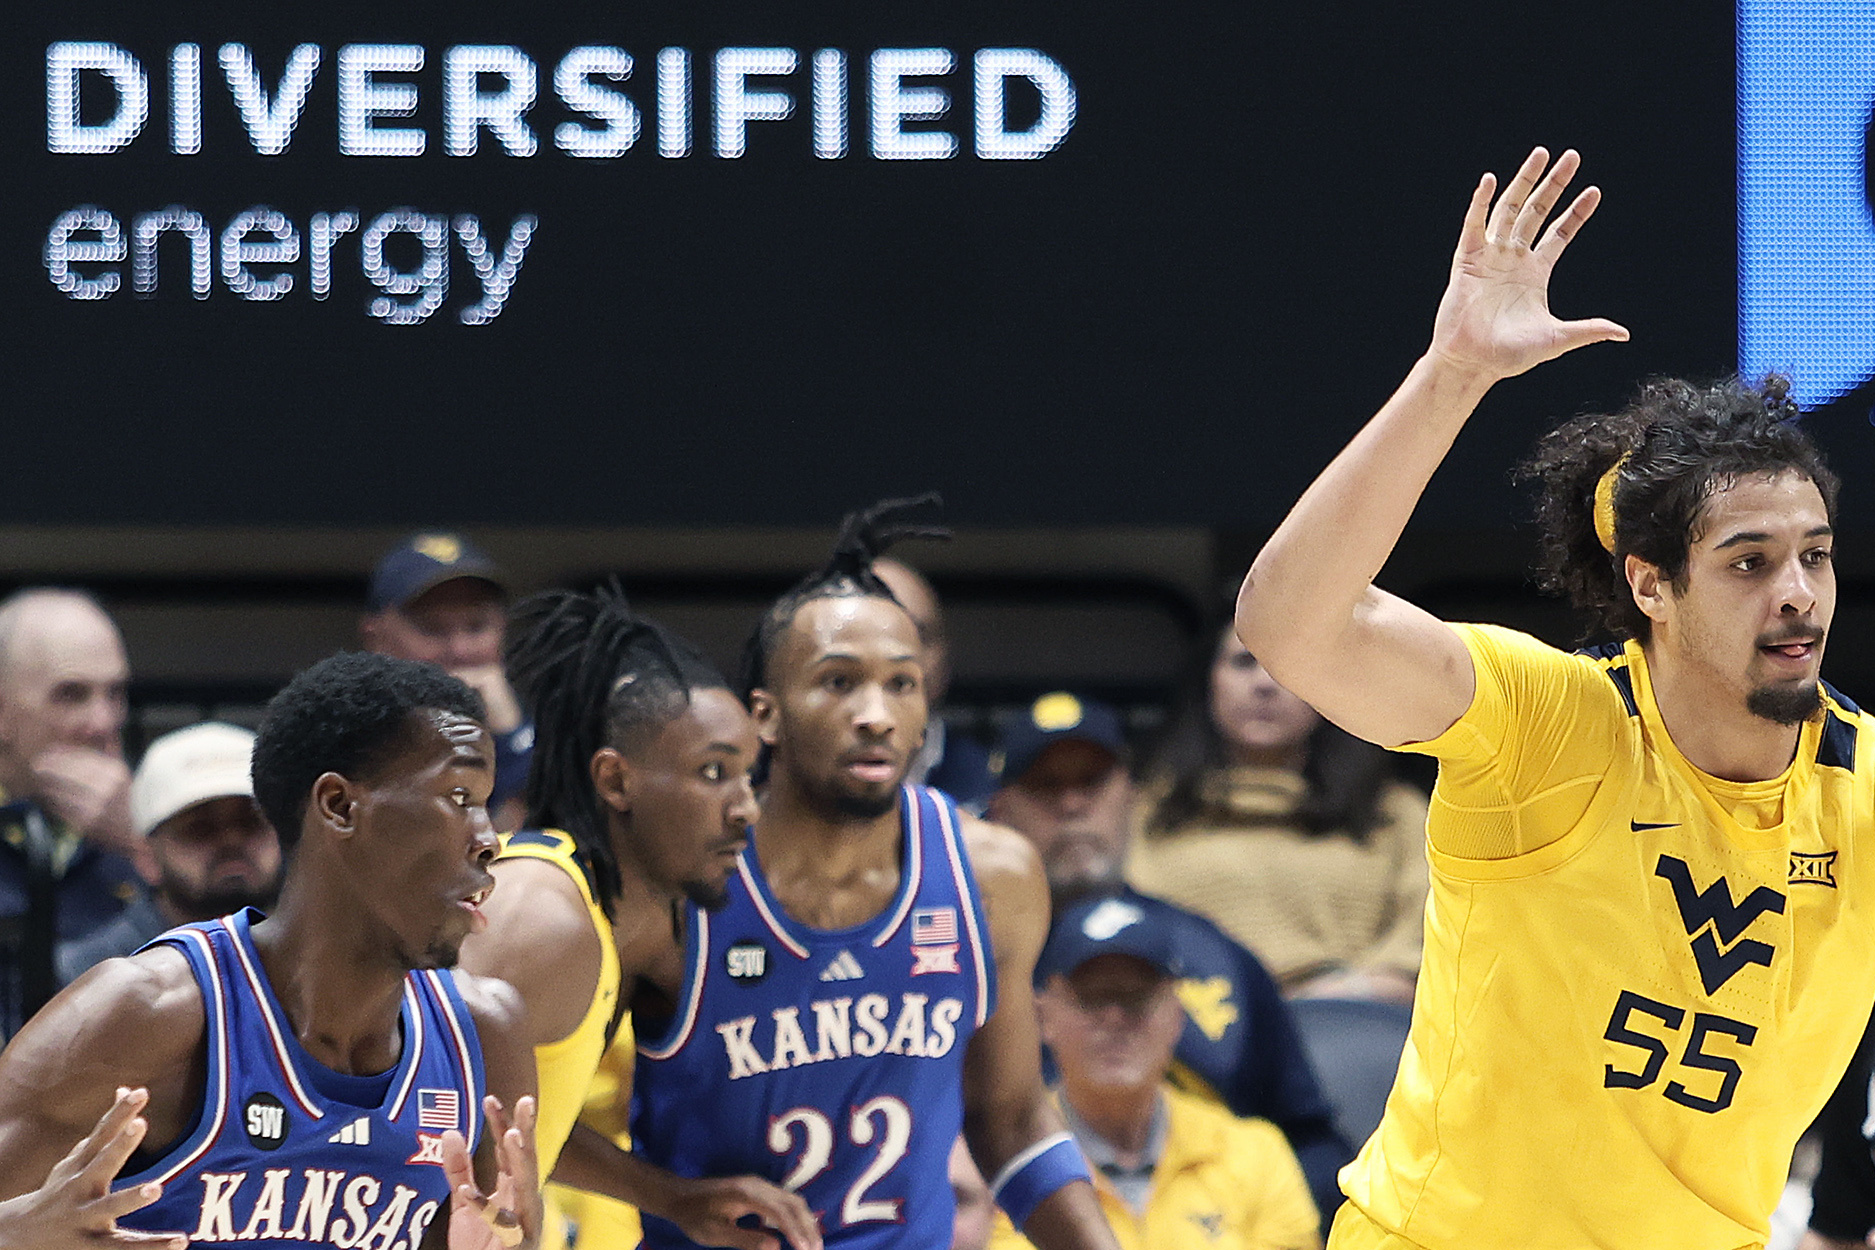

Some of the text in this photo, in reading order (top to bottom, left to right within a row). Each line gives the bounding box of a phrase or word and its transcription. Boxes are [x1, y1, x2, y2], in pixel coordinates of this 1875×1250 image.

[44, 42, 1077, 160] DIVERSIFIED
[44, 203, 538, 326] energy
[715, 993, 963, 1080] KANSAS
[1603, 989, 1758, 1114] 55
[247, 1103, 284, 1140] SW
[767, 1096, 912, 1230] 22
